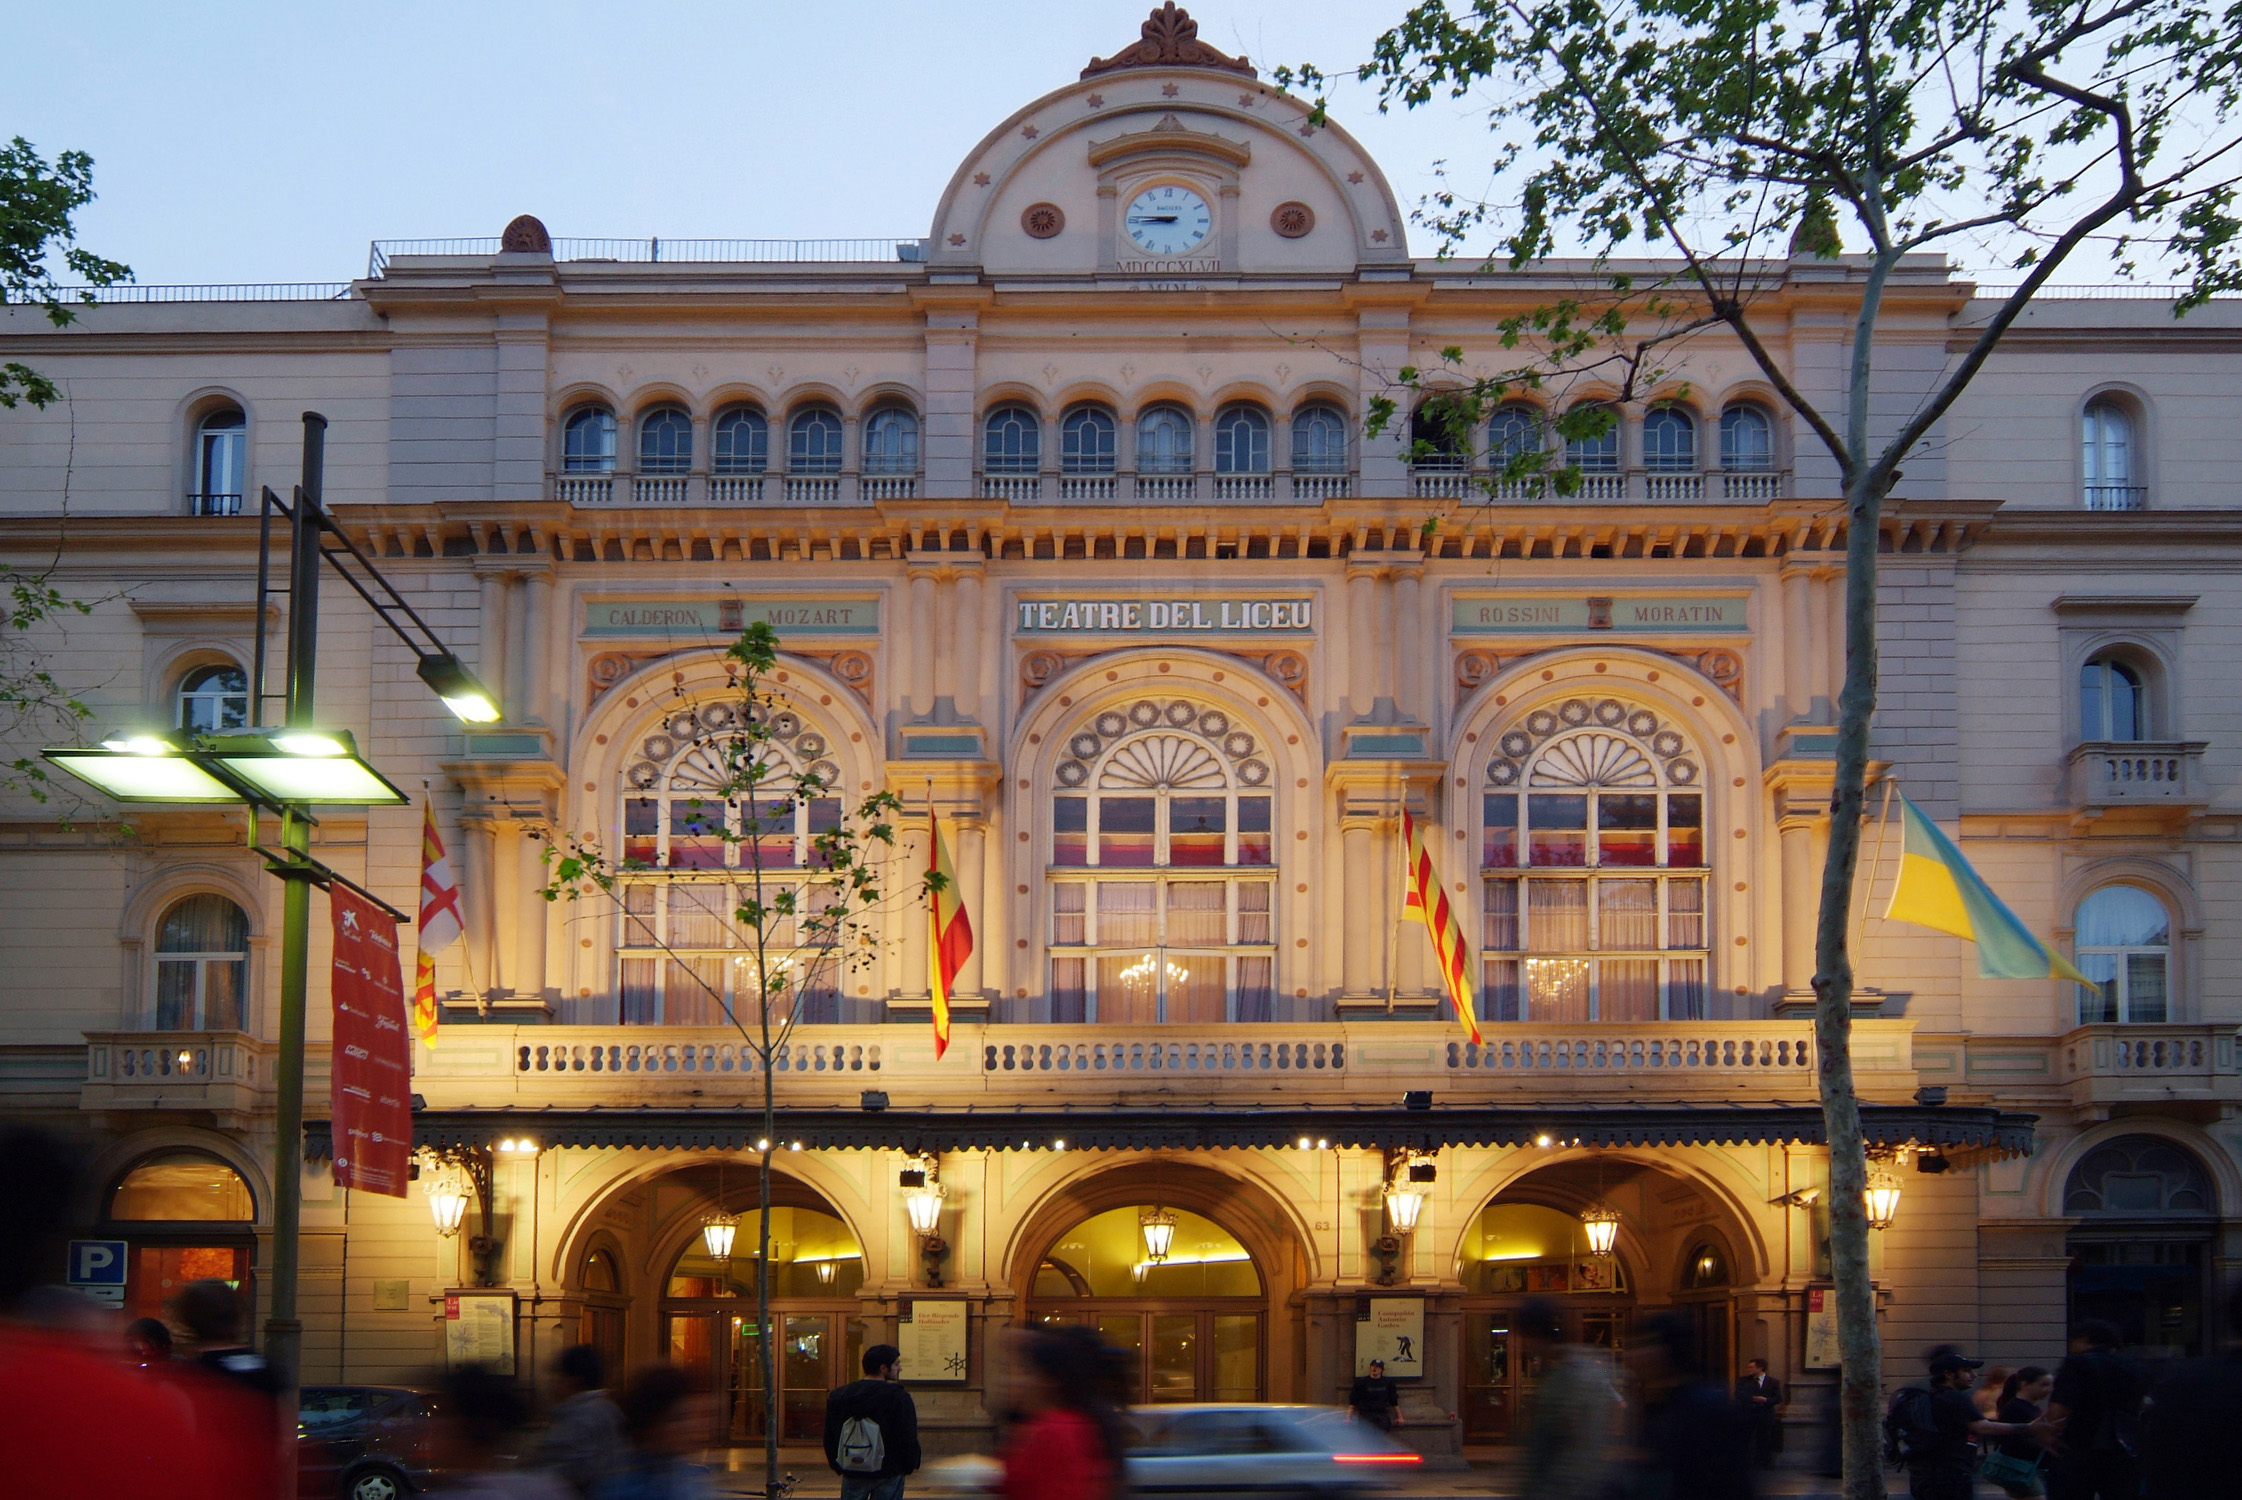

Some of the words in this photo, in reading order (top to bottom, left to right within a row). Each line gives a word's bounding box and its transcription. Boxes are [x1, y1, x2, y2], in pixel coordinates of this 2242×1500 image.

[610, 609, 697, 625] CALDERON
[768, 608, 853, 625] MOZART
[1019, 602, 1142, 630] TEATRE
[1149, 602, 1213, 629] DEL
[1221, 601, 1312, 629] LICEU
[1479, 606, 1560, 623] ROSSINI
[1634, 606, 1723, 622] MORATIN
[1315, 1221, 1329, 1230] 63
[80, 1246, 114, 1279] P
